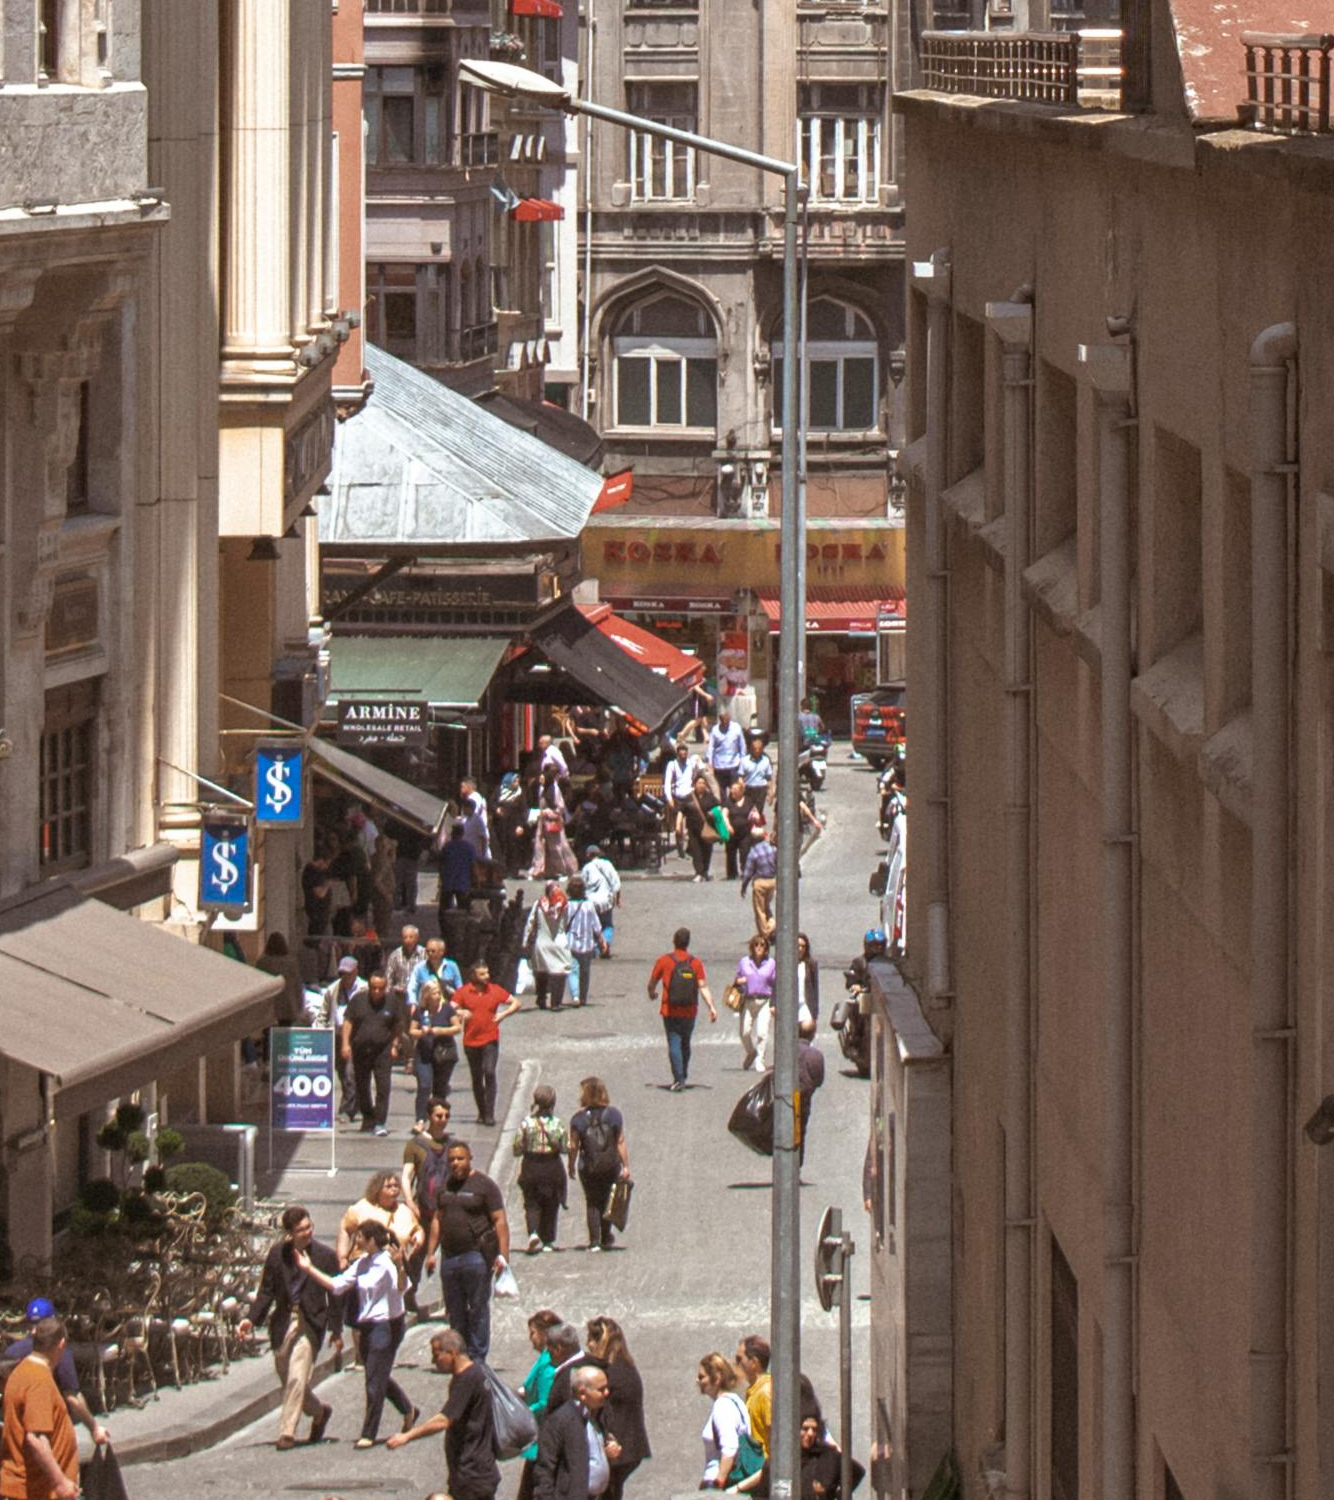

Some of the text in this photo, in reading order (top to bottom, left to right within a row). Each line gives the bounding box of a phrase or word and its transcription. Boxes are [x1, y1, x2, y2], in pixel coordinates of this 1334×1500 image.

[602, 541, 725, 563] KOSKA
[345, 703, 421, 720] ARMİNE
[343, 724, 422, 732] WHOLESALE RETAIL
[273, 1075, 332, 1097] 400
